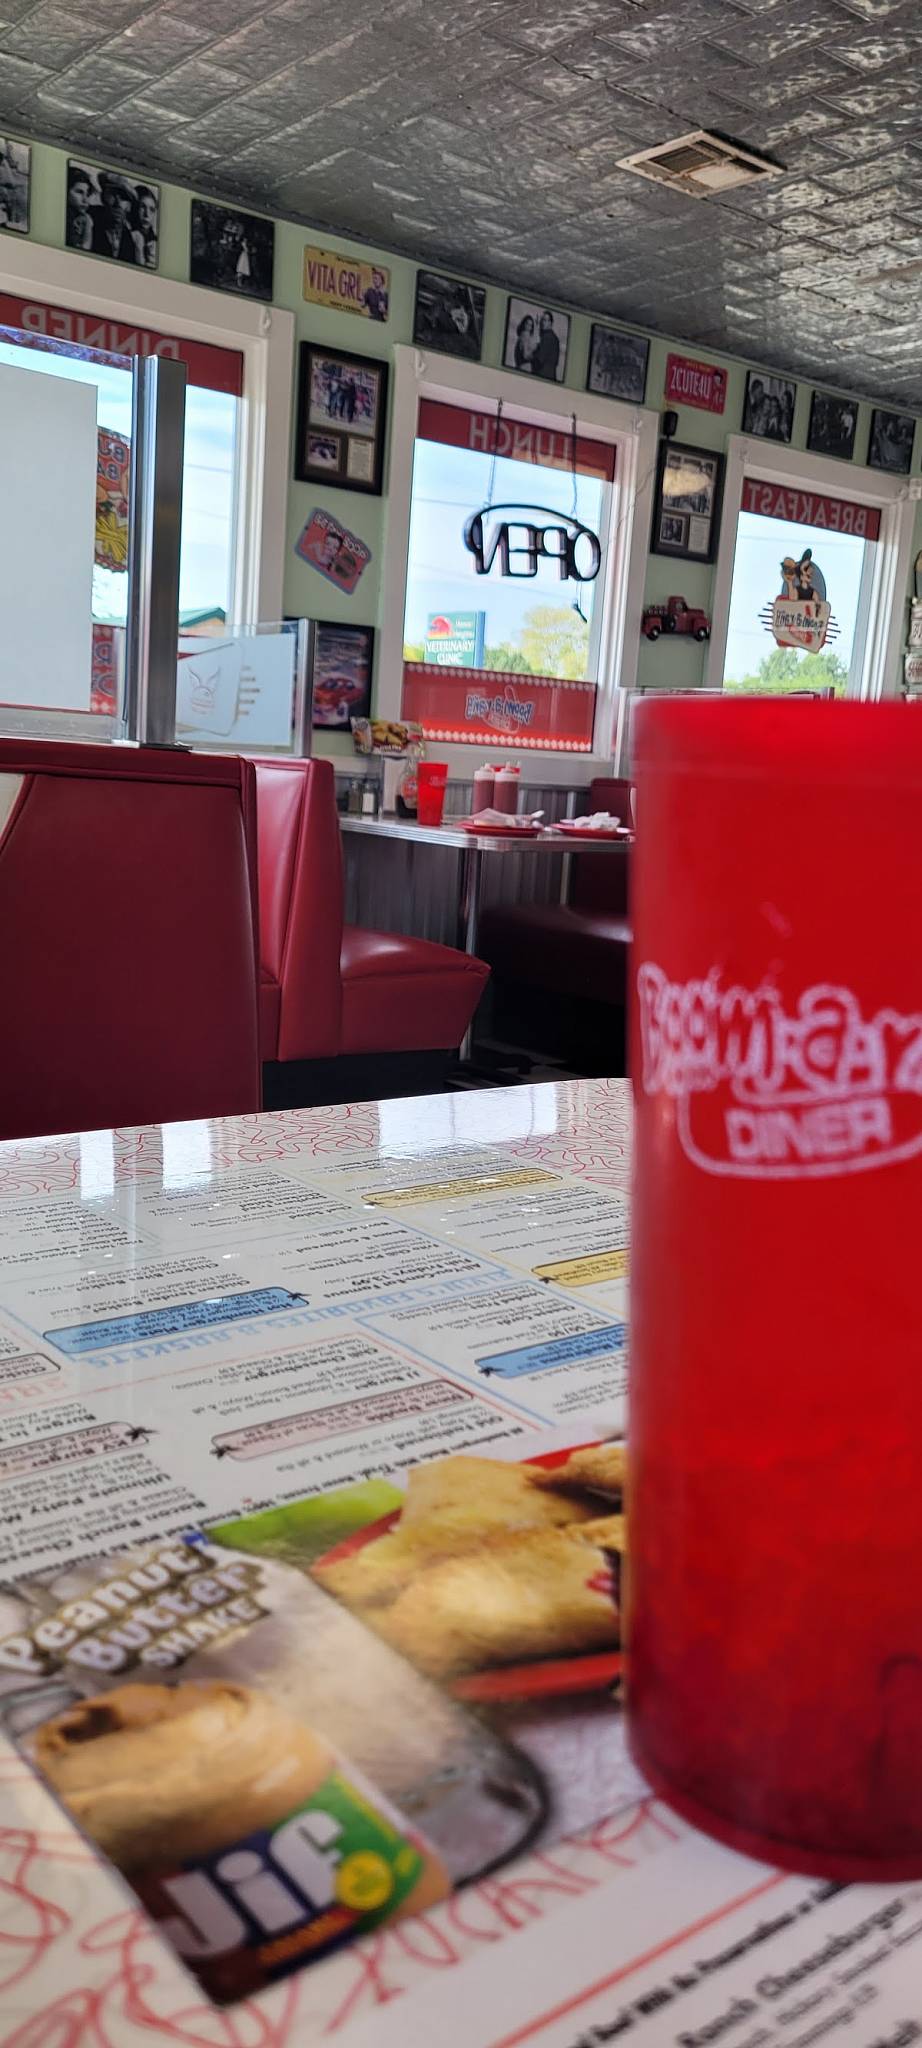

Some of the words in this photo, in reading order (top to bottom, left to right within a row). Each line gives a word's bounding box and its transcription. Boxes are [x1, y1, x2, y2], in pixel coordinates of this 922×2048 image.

[307, 259, 336, 294] VITA
[339, 270, 365, 304] GRL
[425, 639, 474, 652] VETERINARY
[437, 652, 464, 665] CLINIC
[726, 1097, 893, 1159] DINER
[165, 1262, 222, 1275] Chicken
[74, 1279, 127, 1291] Basket
[196, 1279, 252, 1292] Chicken
[321, 1283, 383, 1299] Famous
[90, 1299, 144, 1312] Basket
[0, 1547, 203, 1670] Peanut
[66, 1563, 256, 1670] Butter
[140, 1598, 259, 1668] SHAKE
[157, 1808, 344, 1958] Jif
